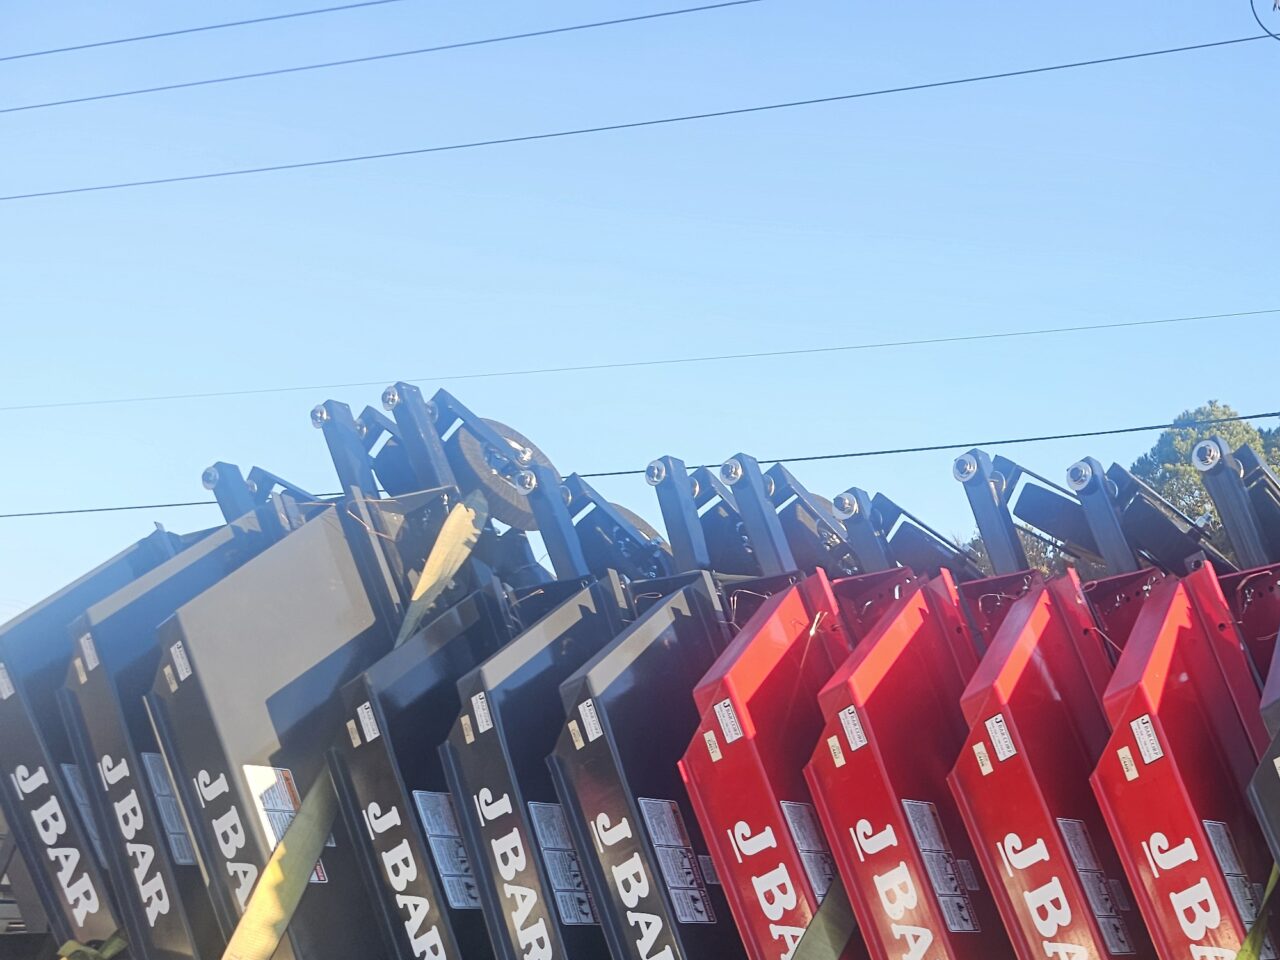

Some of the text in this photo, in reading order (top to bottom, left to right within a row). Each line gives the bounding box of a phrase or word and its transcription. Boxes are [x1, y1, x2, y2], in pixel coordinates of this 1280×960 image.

[722, 700, 729, 708] J
[846, 707, 854, 715] J
[994, 716, 1002, 724] J
[1140, 716, 1148, 725] J
[15, 764, 49, 800] J
[103, 754, 128, 786] J
[368, 802, 401, 834] J
[479, 788, 510, 822] J
[198, 769, 260, 912] J BA
[597, 812, 632, 849] J
[734, 820, 777, 856] J
[856, 819, 898, 858] J
[31, 797, 100, 928] BAR
[111, 789, 171, 928] BAR
[1004, 833, 1050, 873] J
[1149, 832, 1199, 870] J
